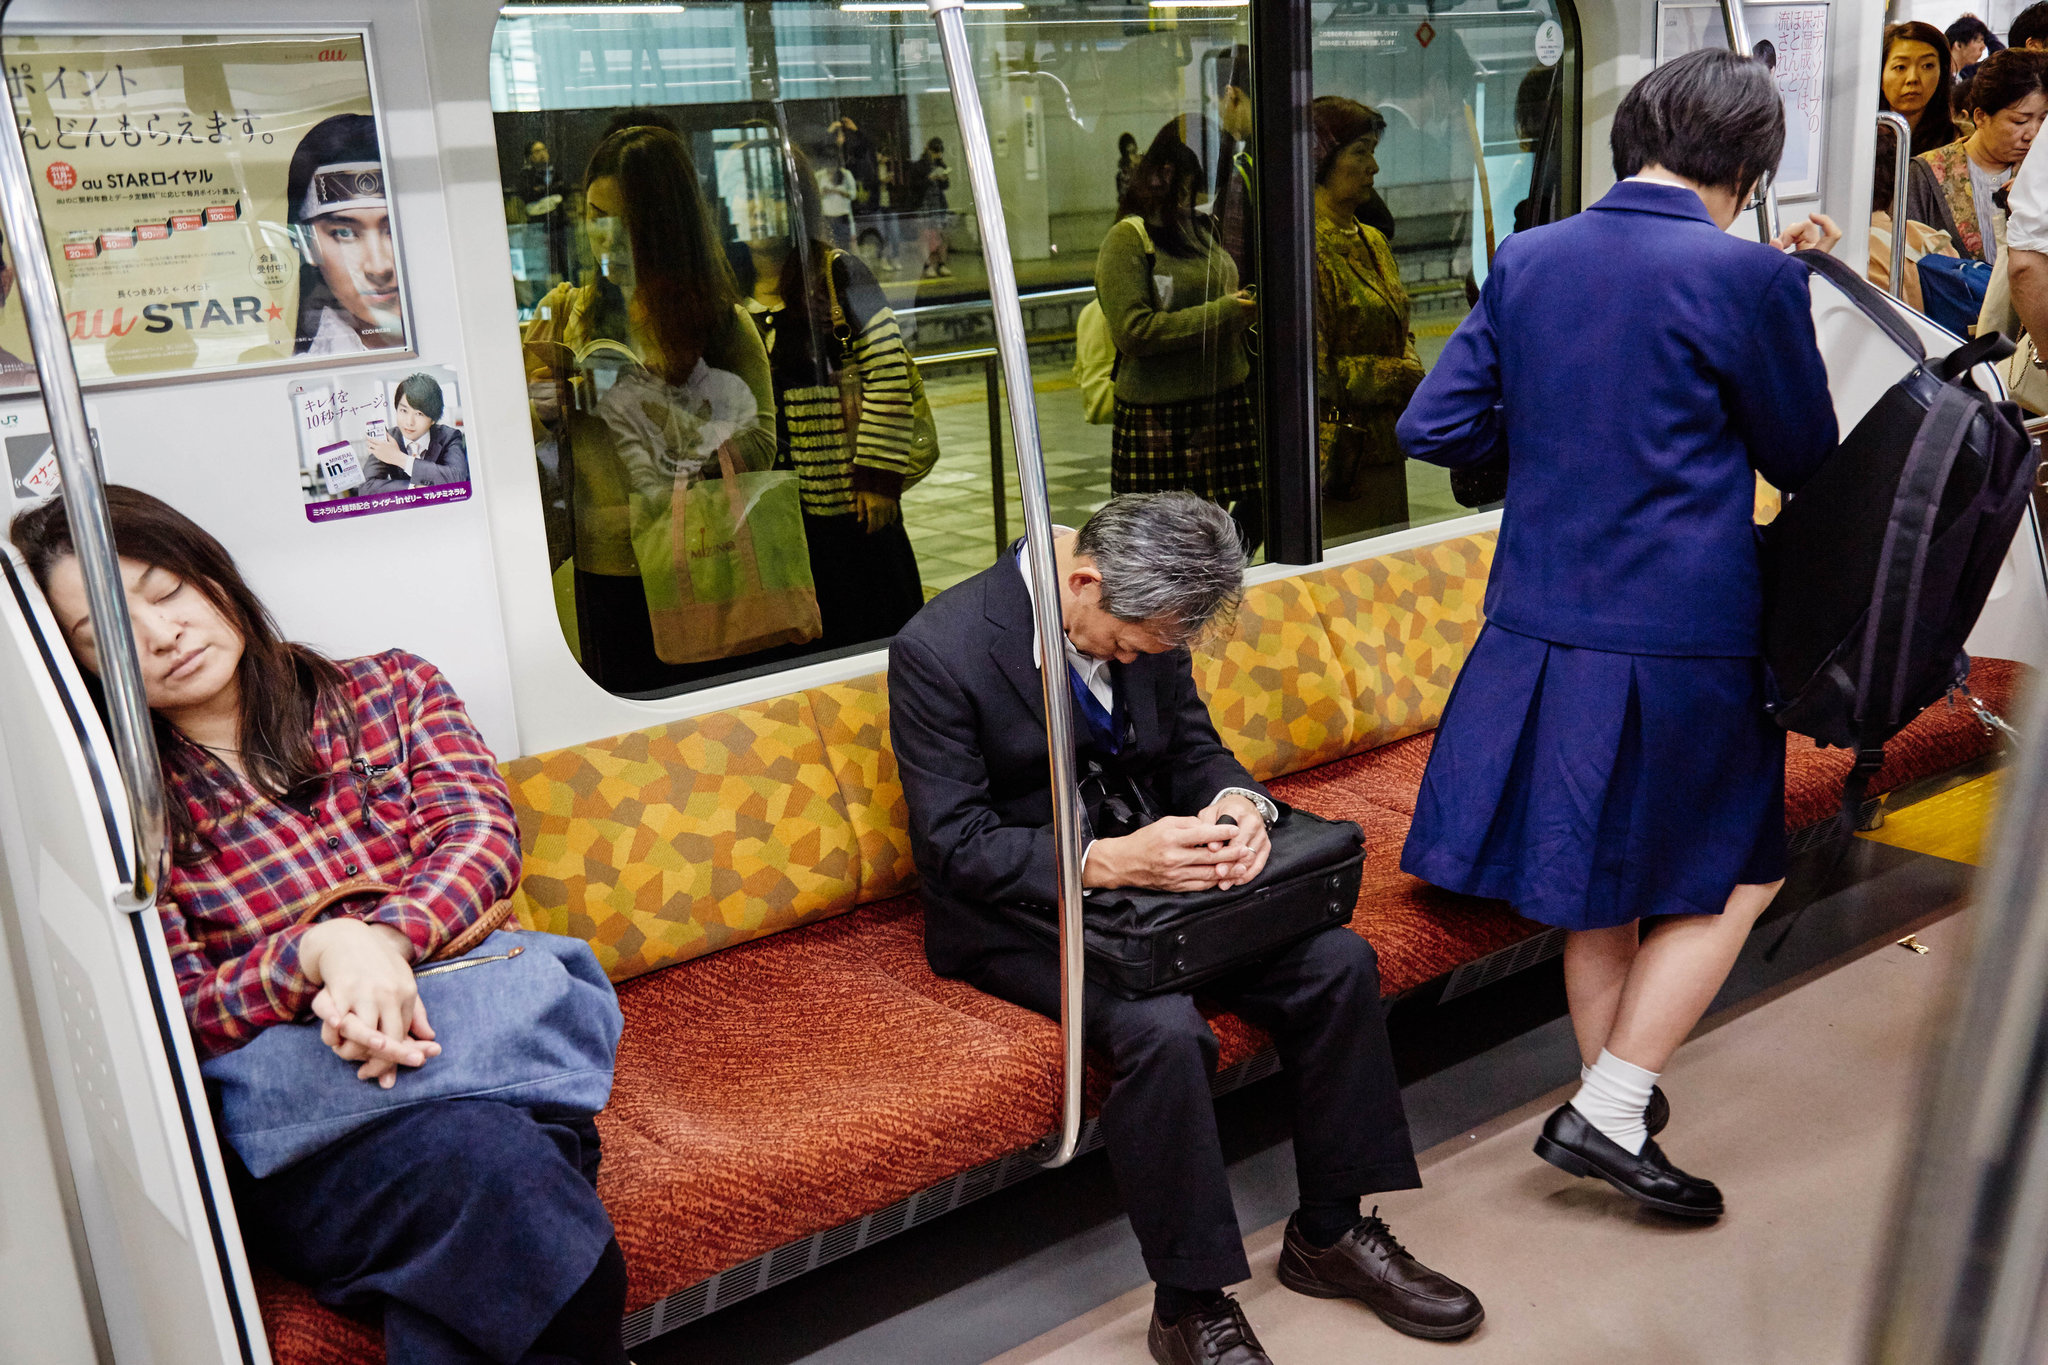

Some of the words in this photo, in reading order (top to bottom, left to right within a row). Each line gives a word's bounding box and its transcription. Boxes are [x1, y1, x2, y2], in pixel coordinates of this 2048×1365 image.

[318, 49, 347, 62] au
[1788, 11, 1801, 93] ほとんど
[1797, 10, 1814, 118] 保湿成分は、
[8, 63, 137, 99] ポイント
[1808, 10, 1825, 134] ボディソープの
[20, 109, 274, 149] んどんもらえます。
[82, 179, 102, 191] au
[65, 307, 138, 341] au
[142, 296, 264, 334] STAR
[305, 390, 349, 412] キレイを
[307, 393, 388, 430] 10秒チャージ。
[1, 415, 19, 426] JR
[29, 459, 54, 485] マナー
[325, 462, 343, 478] in
